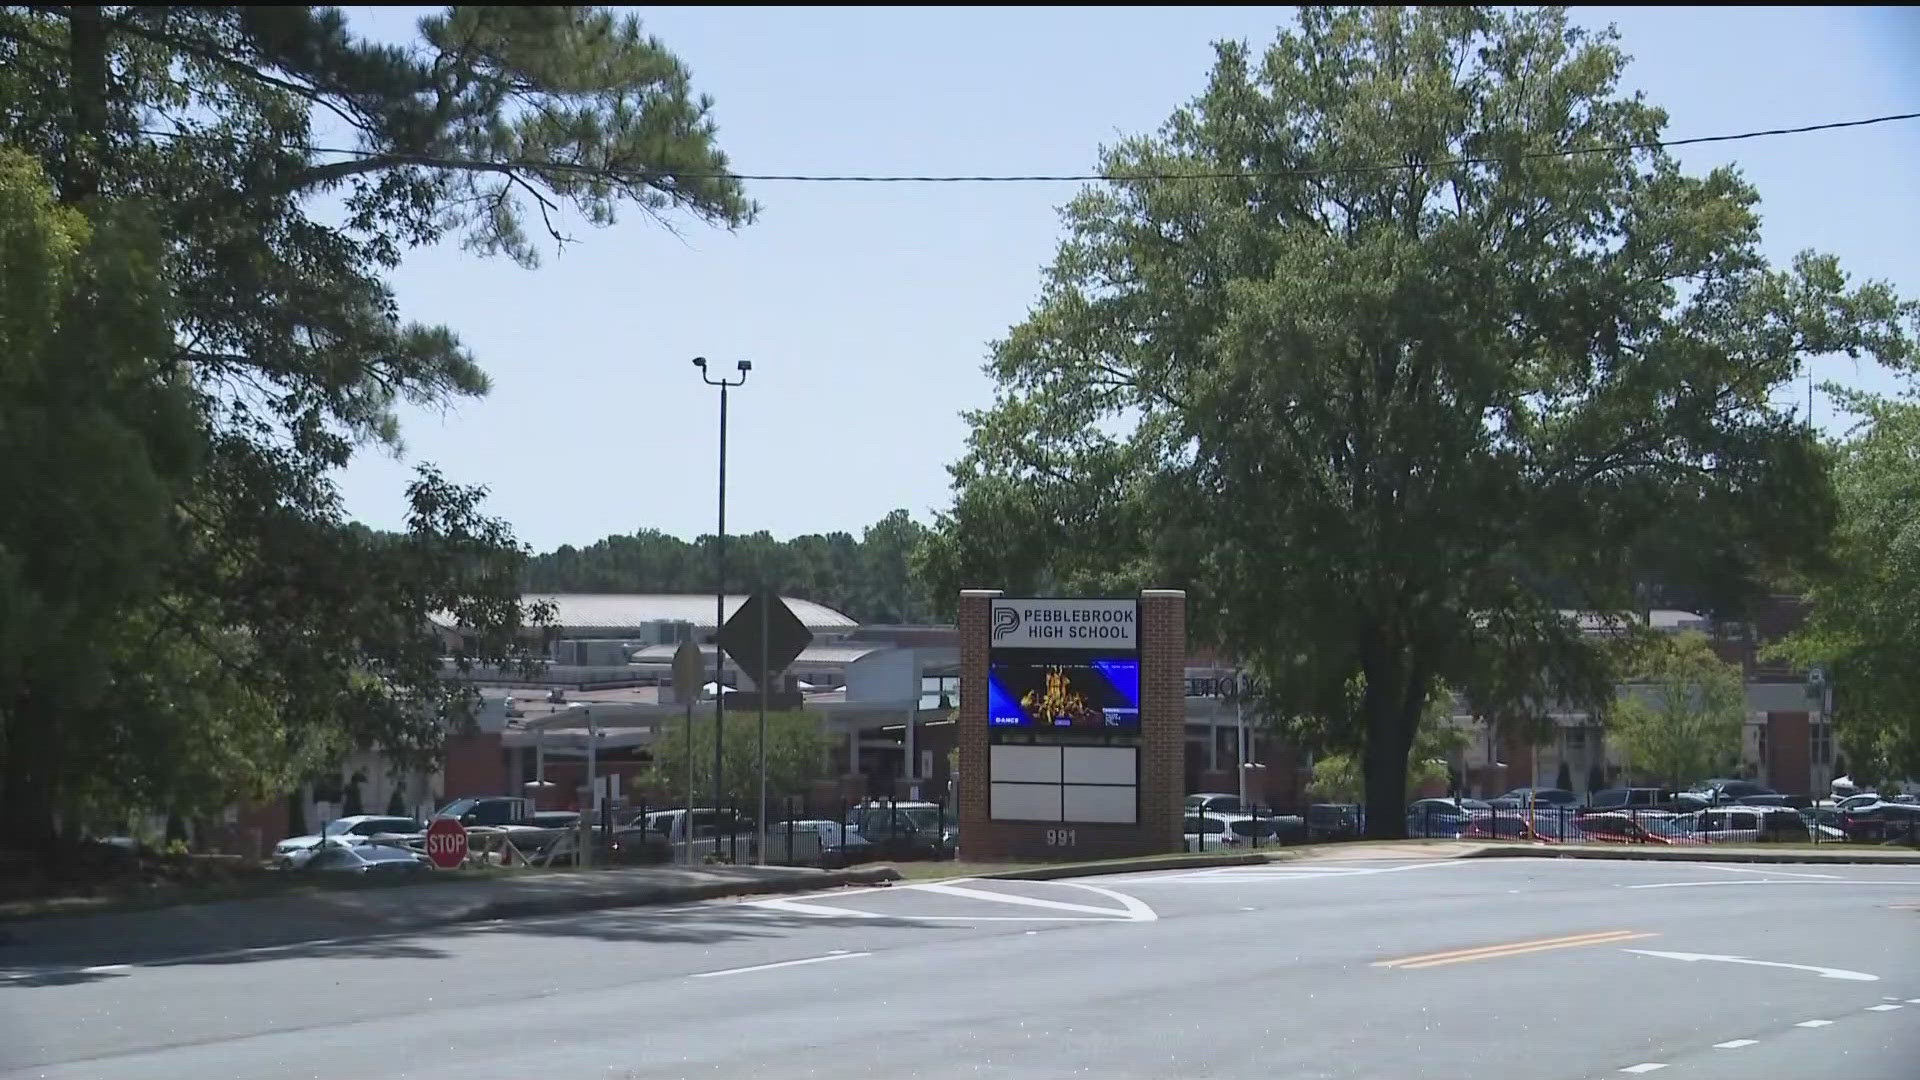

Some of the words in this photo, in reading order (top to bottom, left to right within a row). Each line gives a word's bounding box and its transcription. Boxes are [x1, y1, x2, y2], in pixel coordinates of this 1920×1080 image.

[1024, 610, 1133, 622] PEBBLEBROOK
[1029, 626, 1063, 638] HIGH
[1069, 626, 1128, 638] SCHOOL
[430, 834, 465, 853] STOP
[1047, 829, 1076, 846] 991
